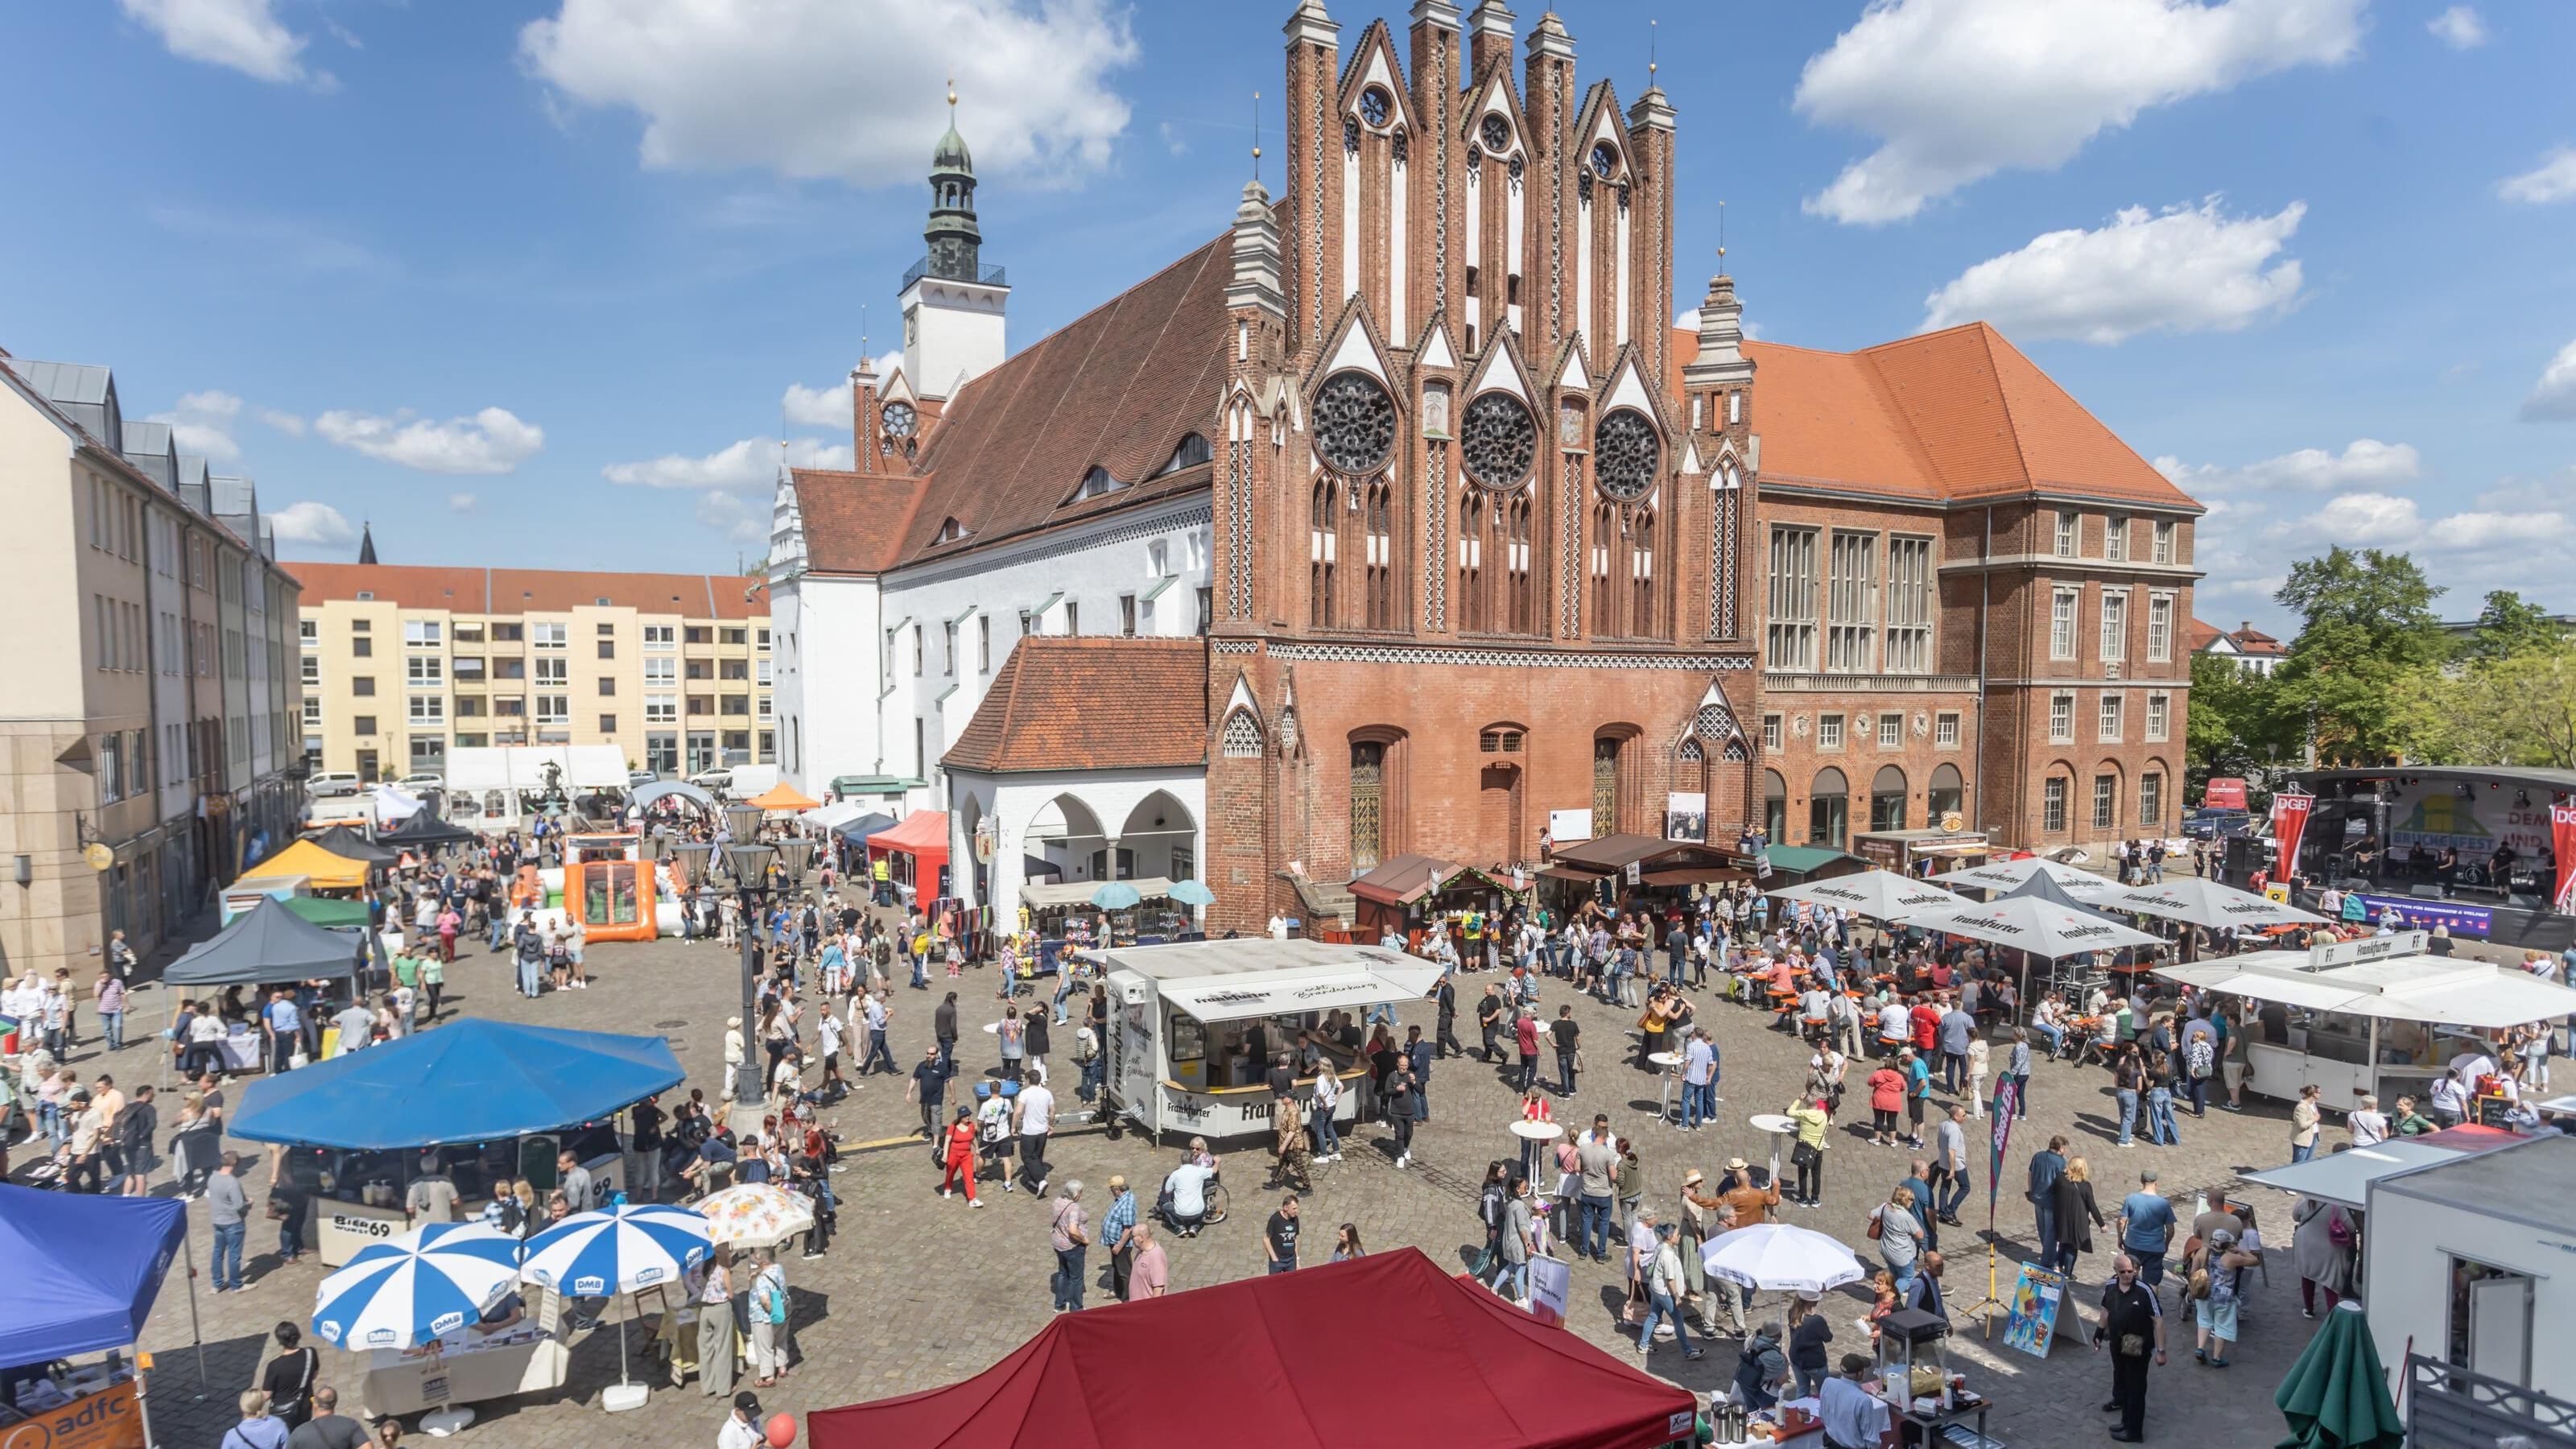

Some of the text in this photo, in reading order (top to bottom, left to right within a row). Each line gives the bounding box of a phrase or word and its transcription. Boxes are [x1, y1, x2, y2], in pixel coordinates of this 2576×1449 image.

[2277, 798, 2308, 811] DGB
[2557, 810, 2576, 824] DG
[1969, 870, 2025, 884] Frankfurter
[2057, 878, 2105, 888] rankfurter
[1810, 886, 1868, 902] Frankfurter
[1897, 894, 1951, 906] Frankfurter
[2122, 894, 2190, 909] Frankfurter
[2222, 903, 2280, 914] Frankfurter
[1951, 914, 2025, 934] Frankfurter
[2057, 925, 2115, 939] Frankfurter
[2357, 941, 2392, 957] Frankfurter
[1195, 991, 1273, 1005] Frankfurter
[1167, 1102, 1211, 1118] Frankfurter
[593, 1176, 612, 1196] 69
[369, 1221, 390, 1237] 69
[578, 1280, 601, 1289] DMB
[434, 1315, 460, 1330] DMB
[55, 1397, 126, 1436] adfc
